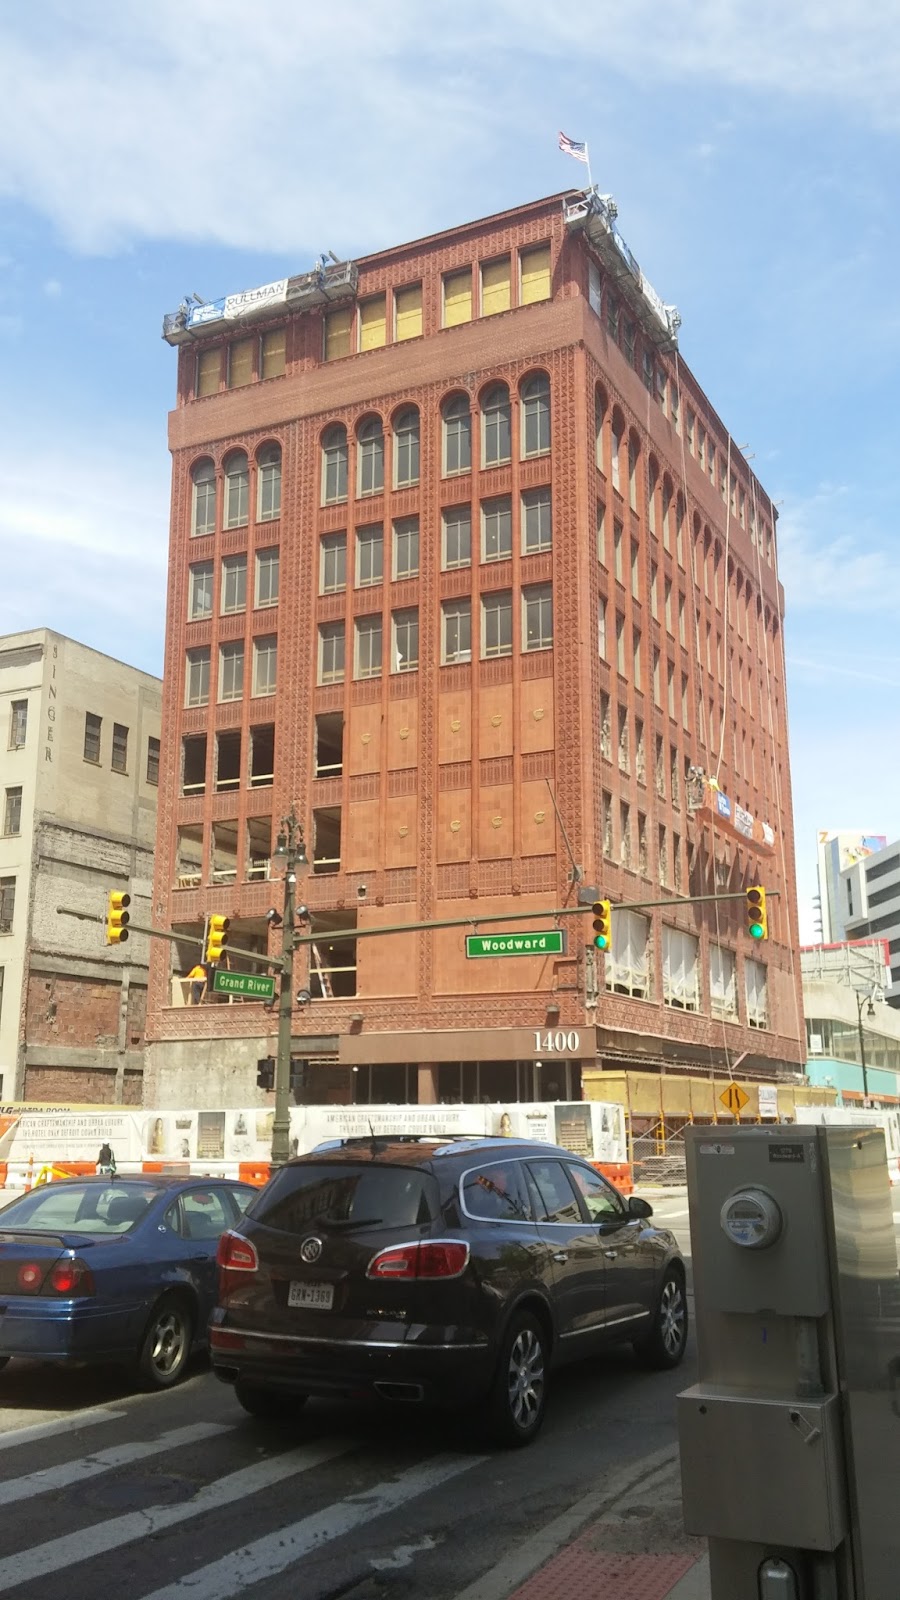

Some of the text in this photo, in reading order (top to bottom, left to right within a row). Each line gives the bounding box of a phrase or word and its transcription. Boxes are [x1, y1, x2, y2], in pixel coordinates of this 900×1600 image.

[227, 282, 285, 305] PULLMAN
[45, 645, 58, 763] SINGER
[481, 937, 546, 951] Woodward
[219, 975, 270, 992] Grand River
[533, 1031, 580, 1052] 1400
